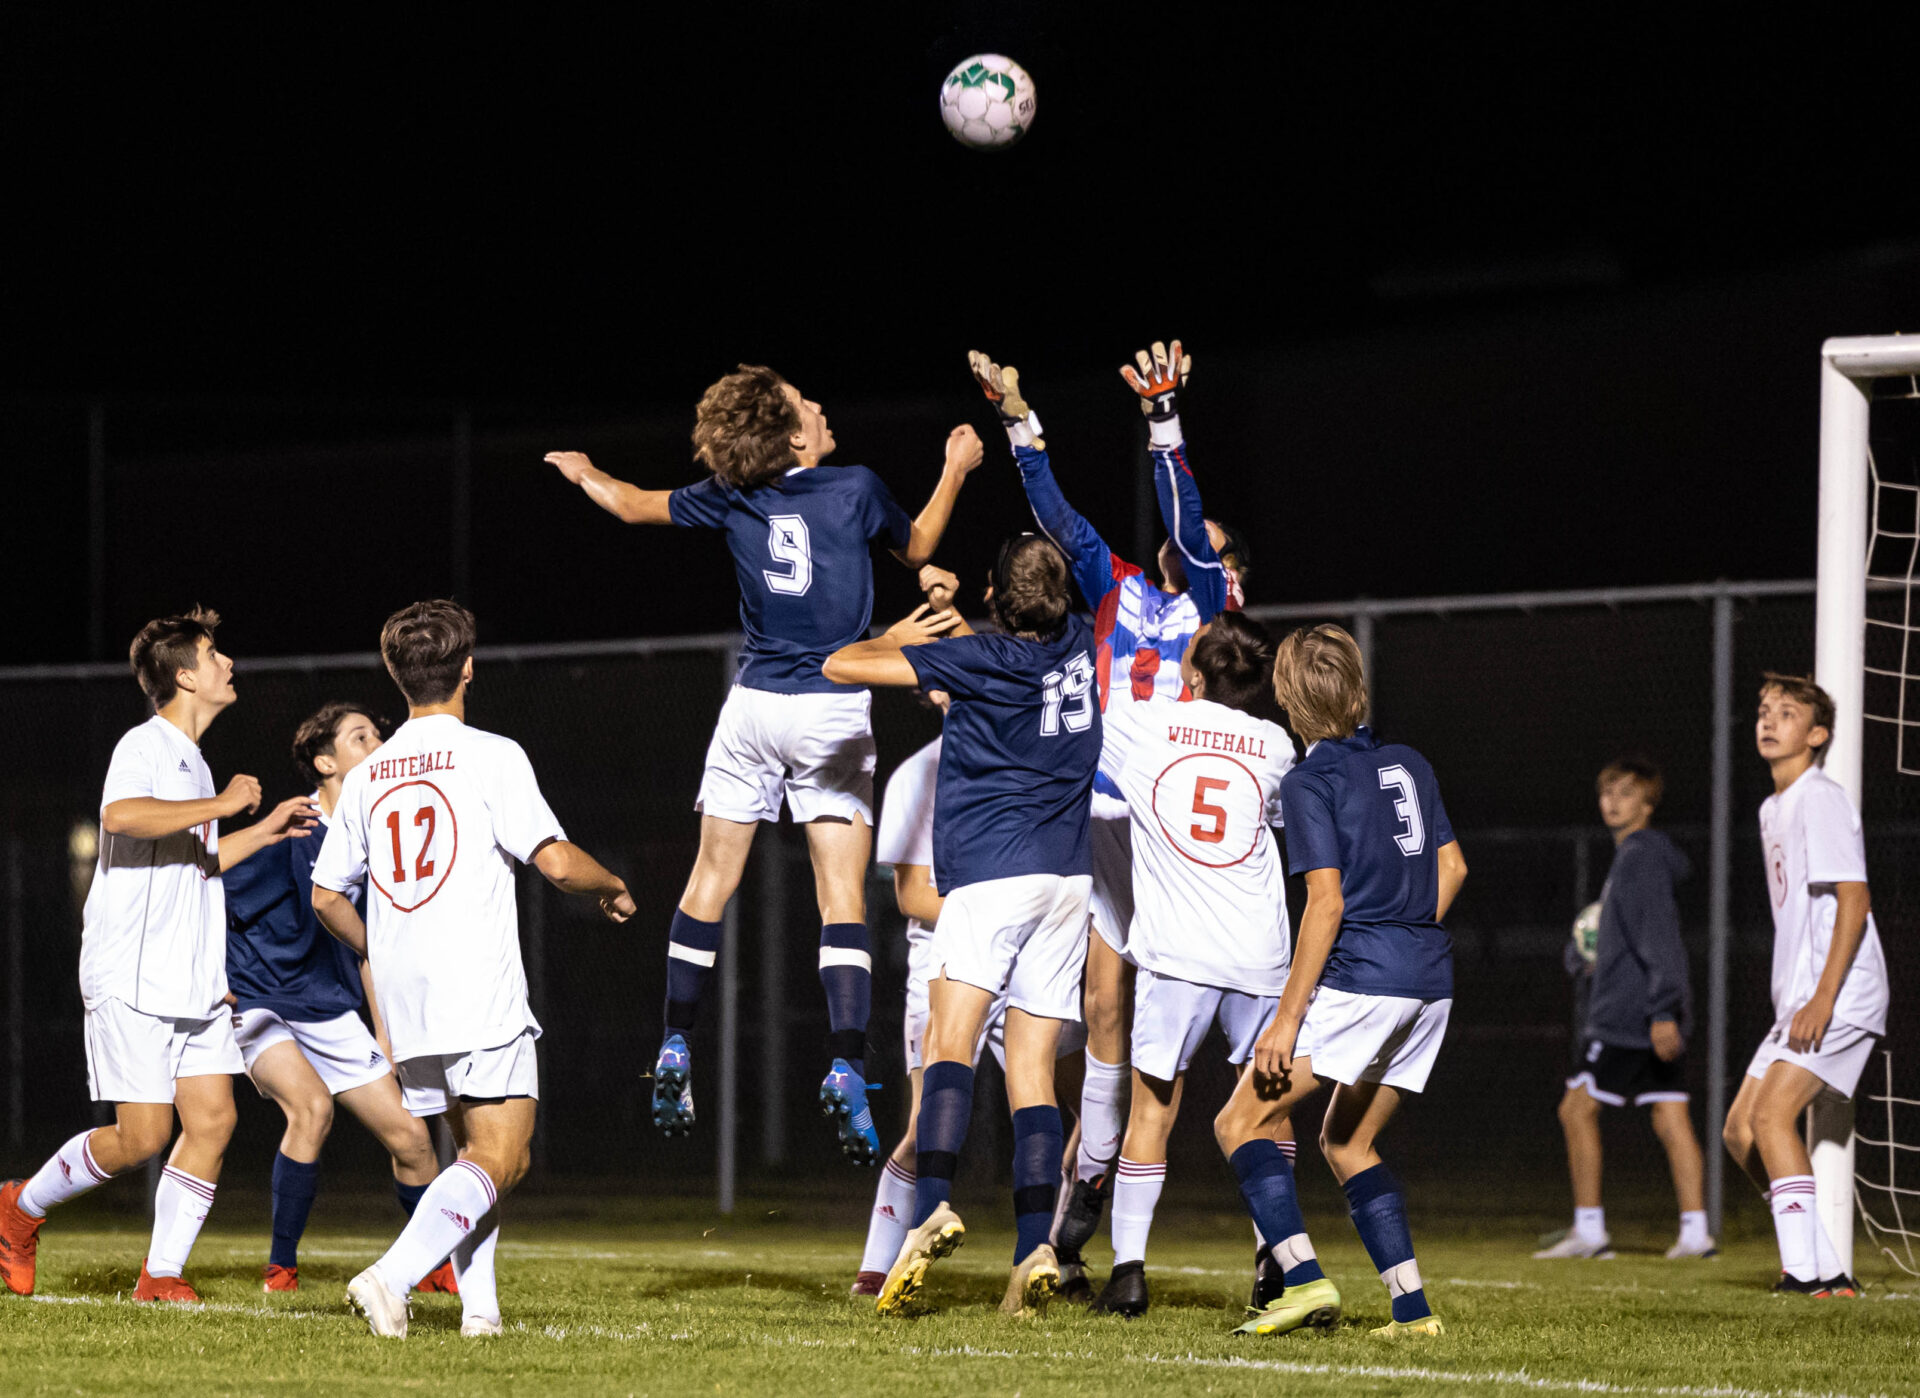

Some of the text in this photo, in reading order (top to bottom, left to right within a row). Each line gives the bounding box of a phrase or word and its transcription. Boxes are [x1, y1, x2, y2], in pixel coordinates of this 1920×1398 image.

[763, 514, 812, 596] 9
[1040, 650, 1095, 736] 19
[369, 751, 455, 783] WHITEHALL
[1168, 726, 1267, 759] WHITEHALL
[387, 806, 436, 883] 12
[1190, 776, 1231, 844] 5
[1378, 764, 1425, 856] 3
